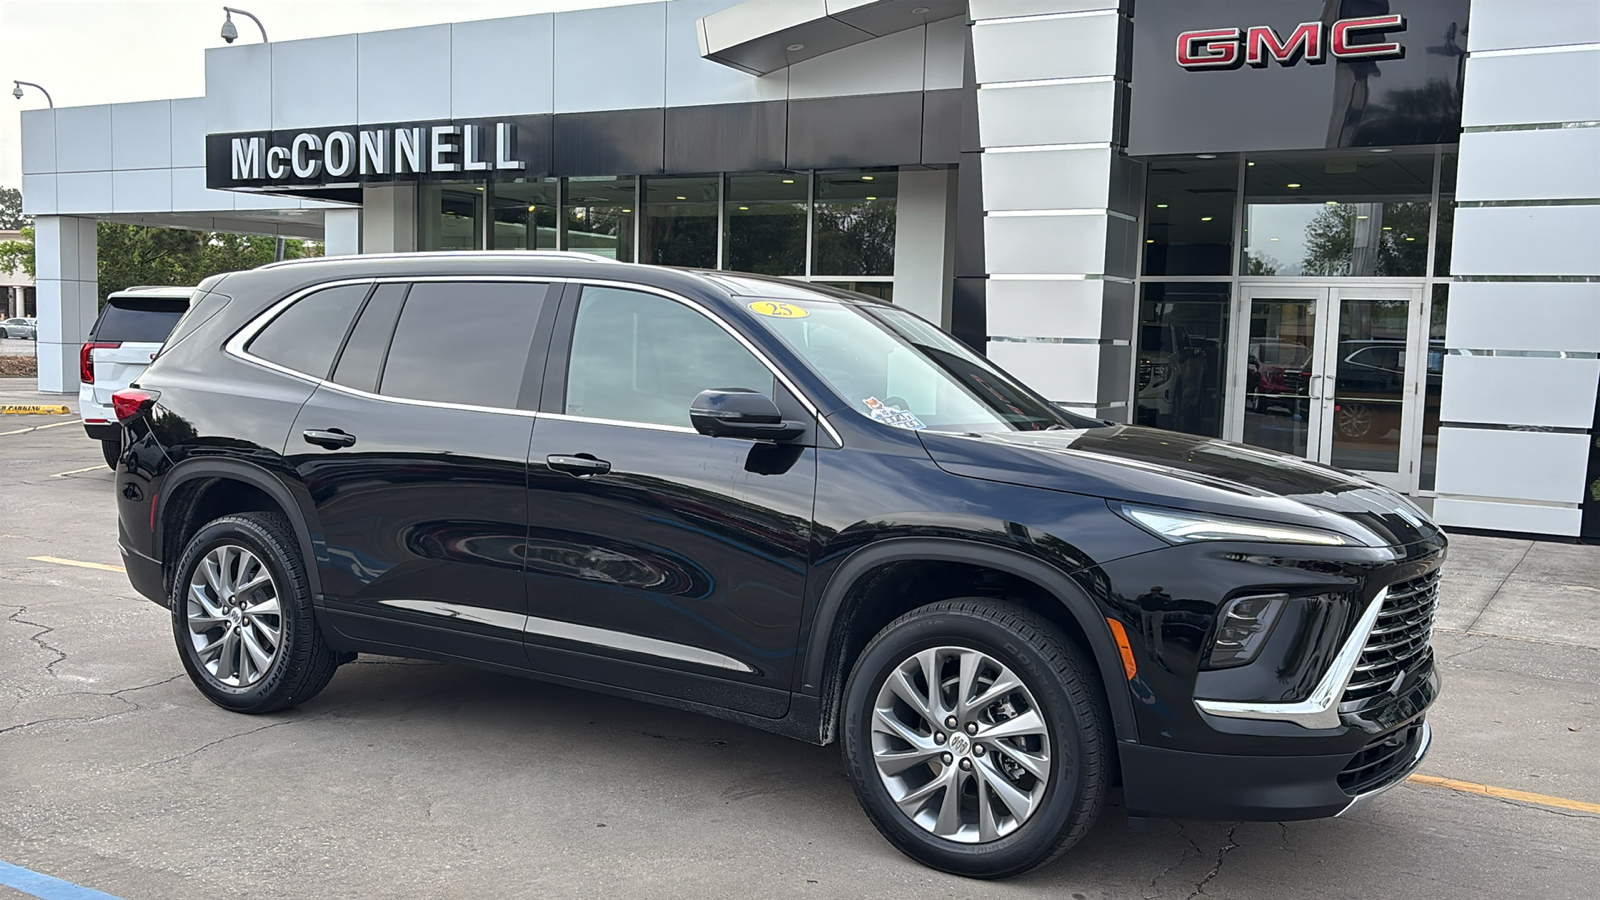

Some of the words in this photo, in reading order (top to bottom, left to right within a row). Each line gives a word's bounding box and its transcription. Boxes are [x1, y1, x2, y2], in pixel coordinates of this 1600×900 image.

[1176, 14, 1404, 68] GMC
[231, 122, 524, 180] McCONNELL
[765, 302, 793, 316] 25
[255, 608, 292, 698] CONTINENTAL
